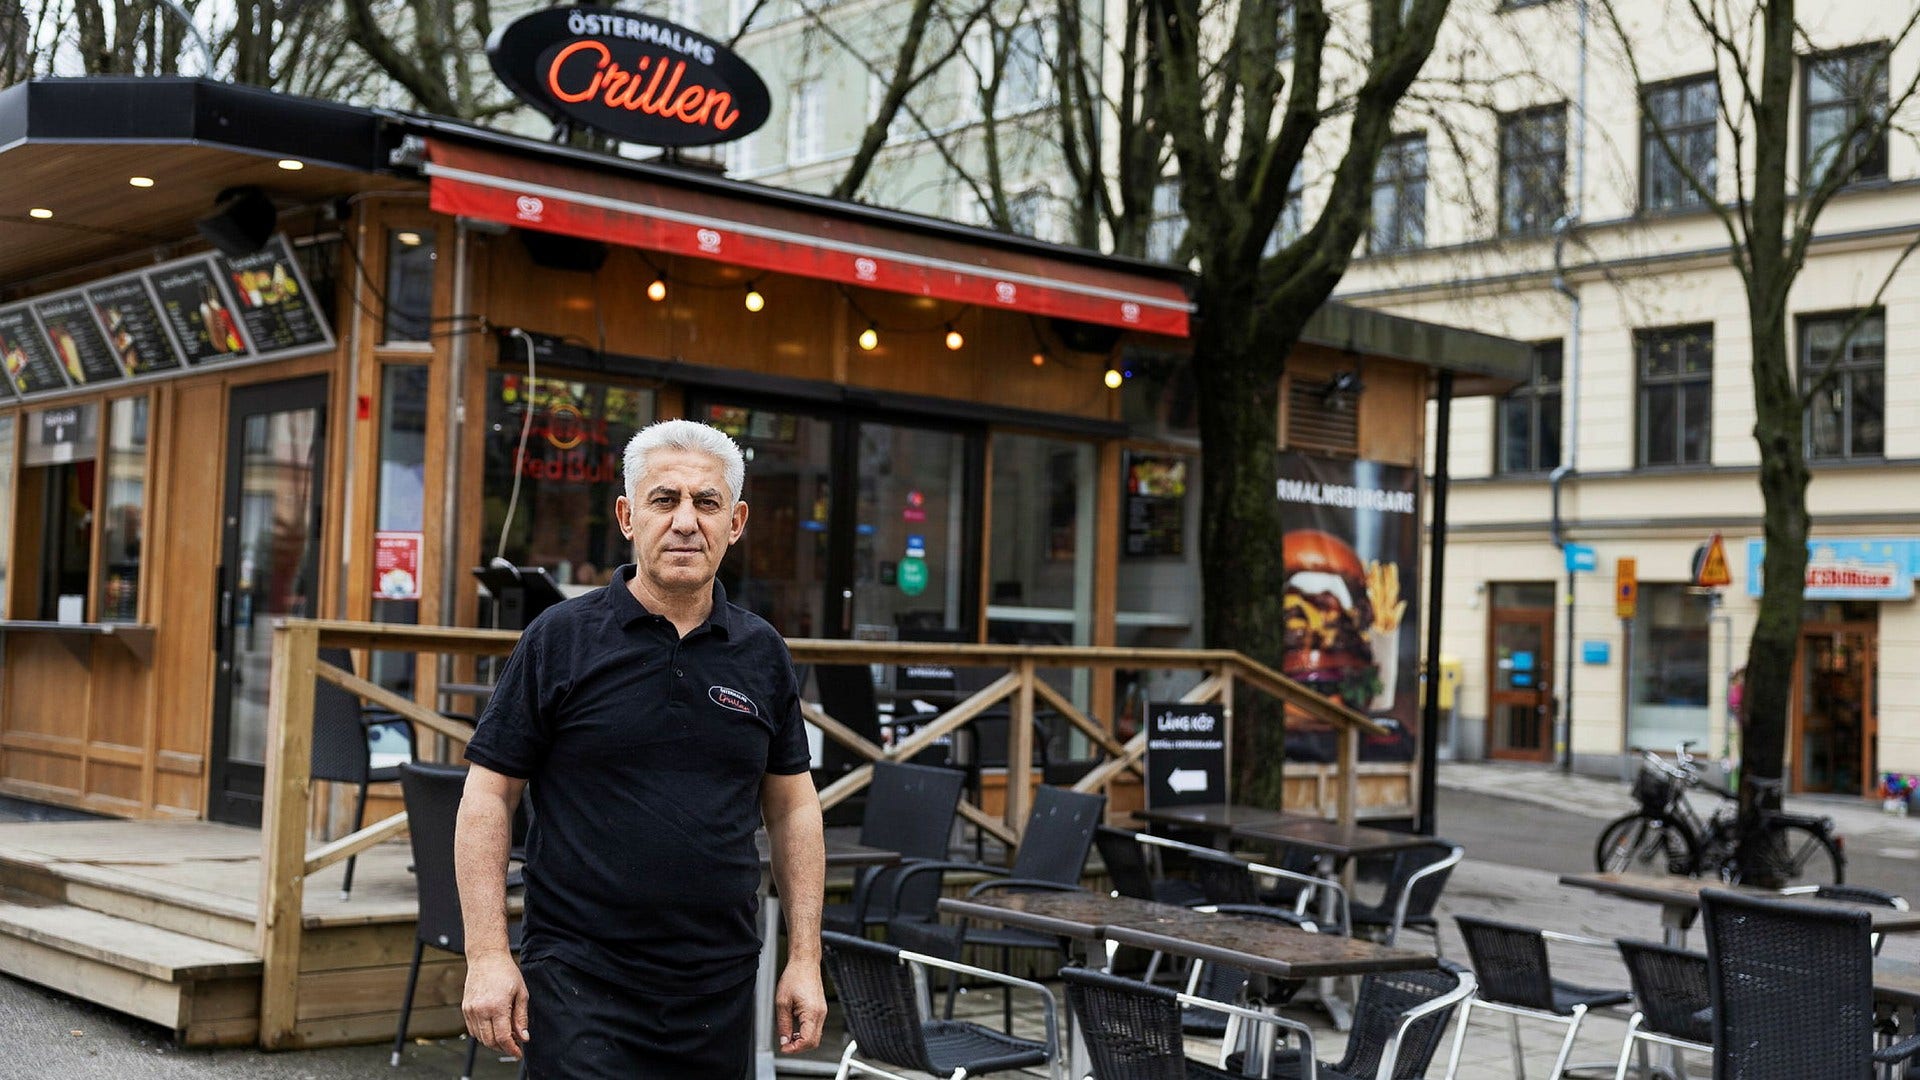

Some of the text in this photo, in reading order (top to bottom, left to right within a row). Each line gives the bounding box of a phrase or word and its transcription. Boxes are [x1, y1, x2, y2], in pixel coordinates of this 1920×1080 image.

[568, 10, 716, 66] ÖSTERMALMS
[548, 39, 741, 130] Grillen
[513, 447, 616, 483] Red Bull
[1275, 478, 1416, 515] RMALMSBURGARE
[1157, 711, 1190, 732] LÅNG
